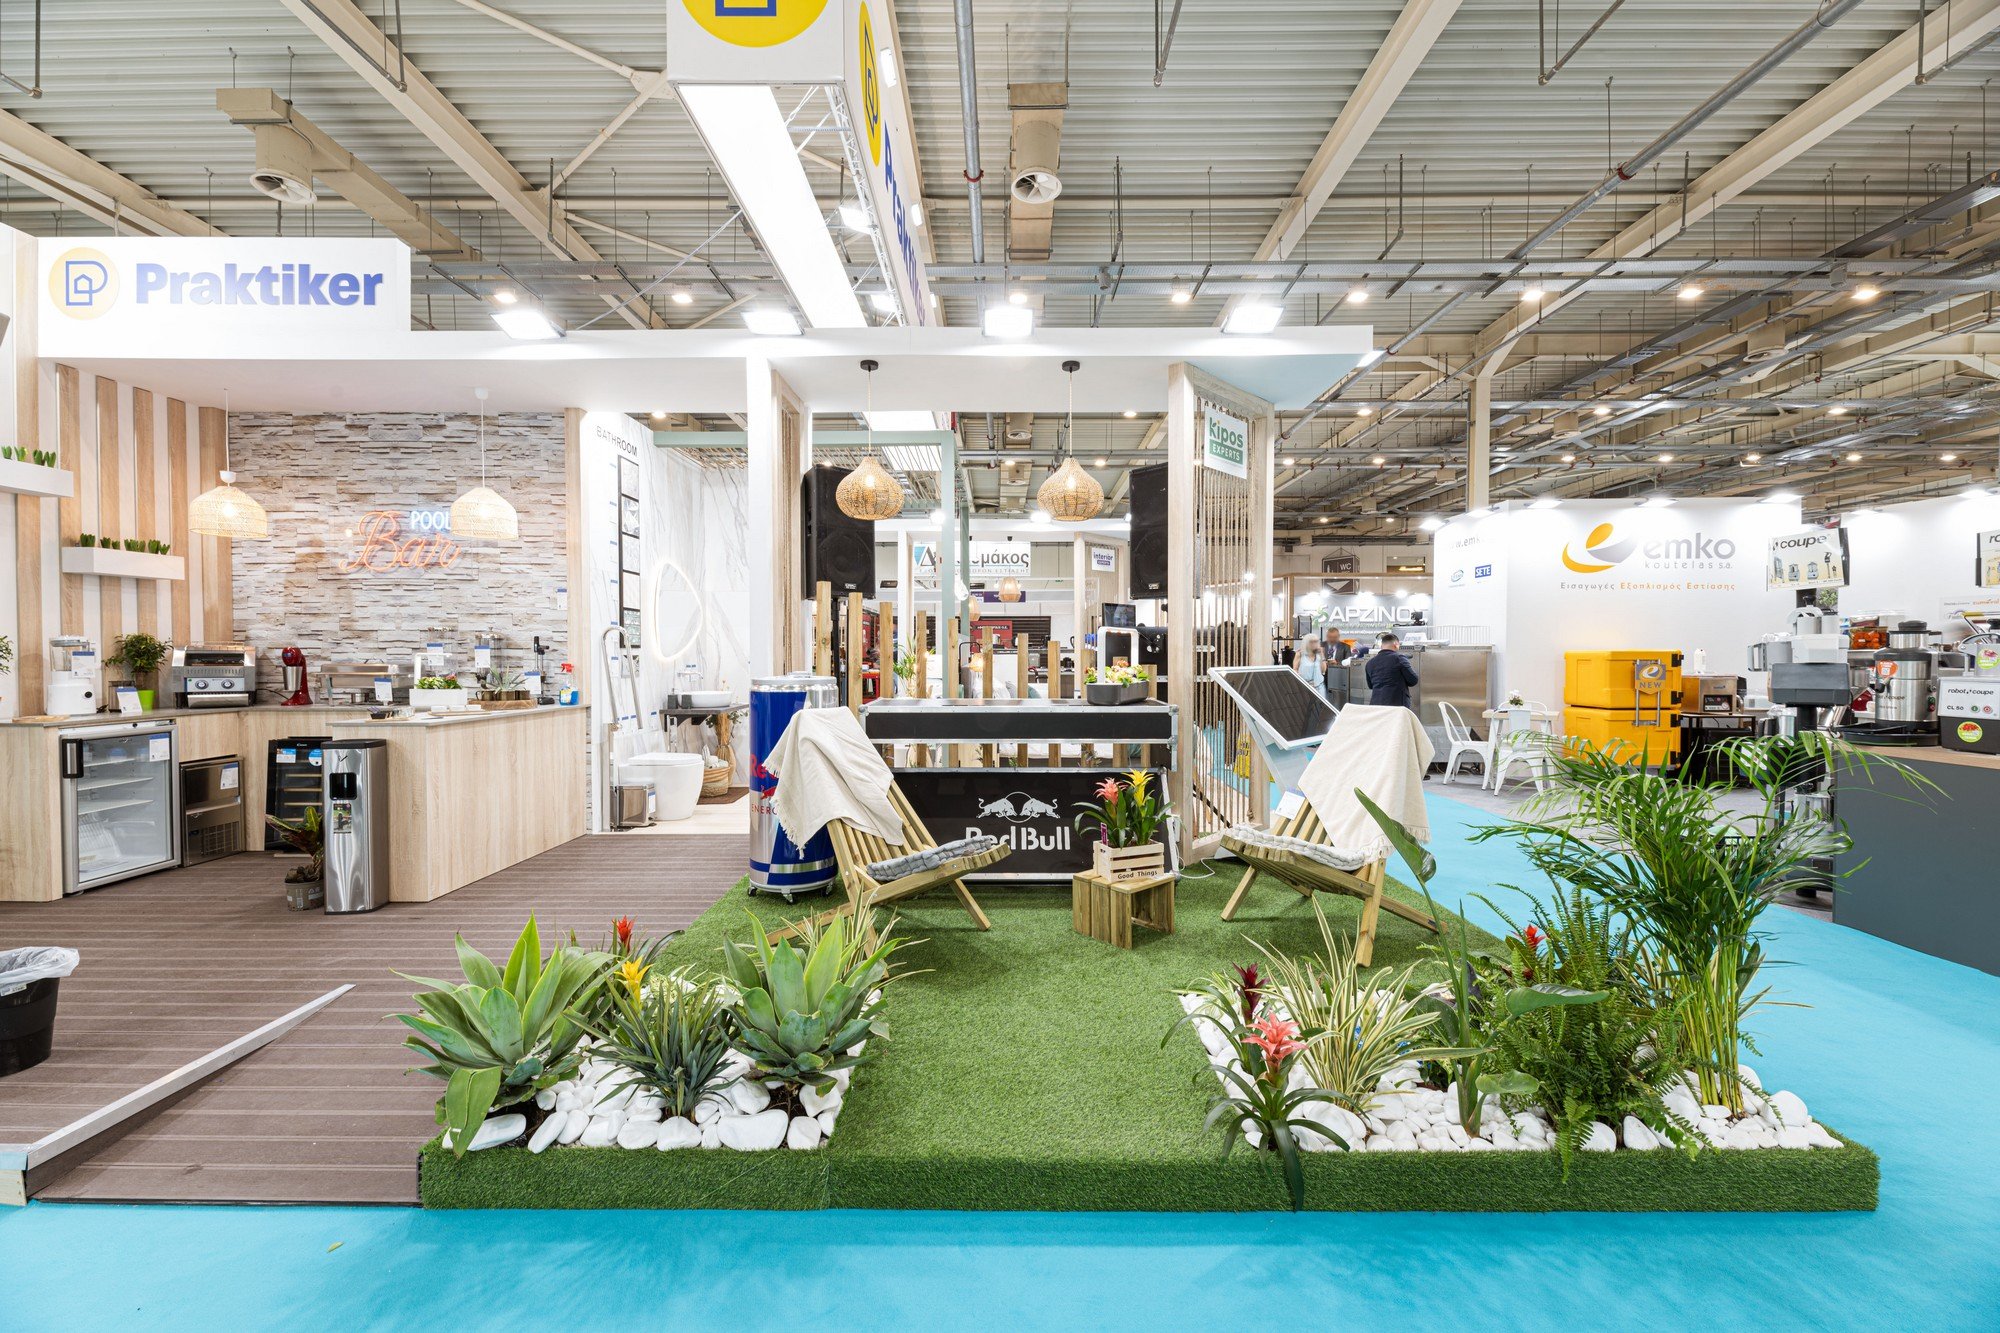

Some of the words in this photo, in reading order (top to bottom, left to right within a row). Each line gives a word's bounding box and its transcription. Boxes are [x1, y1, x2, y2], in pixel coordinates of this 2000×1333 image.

[136, 263, 383, 305] Praktiker
[596, 425, 638, 457] BATHROOM
[1209, 417, 1244, 448] kipos
[1212, 443, 1241, 461] EXPERTS
[339, 510, 461, 572] Bar
[1643, 532, 1736, 560] emko
[1780, 536, 1827, 549] coupe
[1340, 562, 1352, 571] WC
[1645, 561, 1713, 569] koutelas
[1560, 582, 1615, 592] Εισαγωγές
[1620, 582, 1682, 592] Εξοπλισμός
[1687, 582, 1736, 592] Εστίασης
[750, 753, 777, 779] Re
[1021, 826, 1071, 851] Bull
